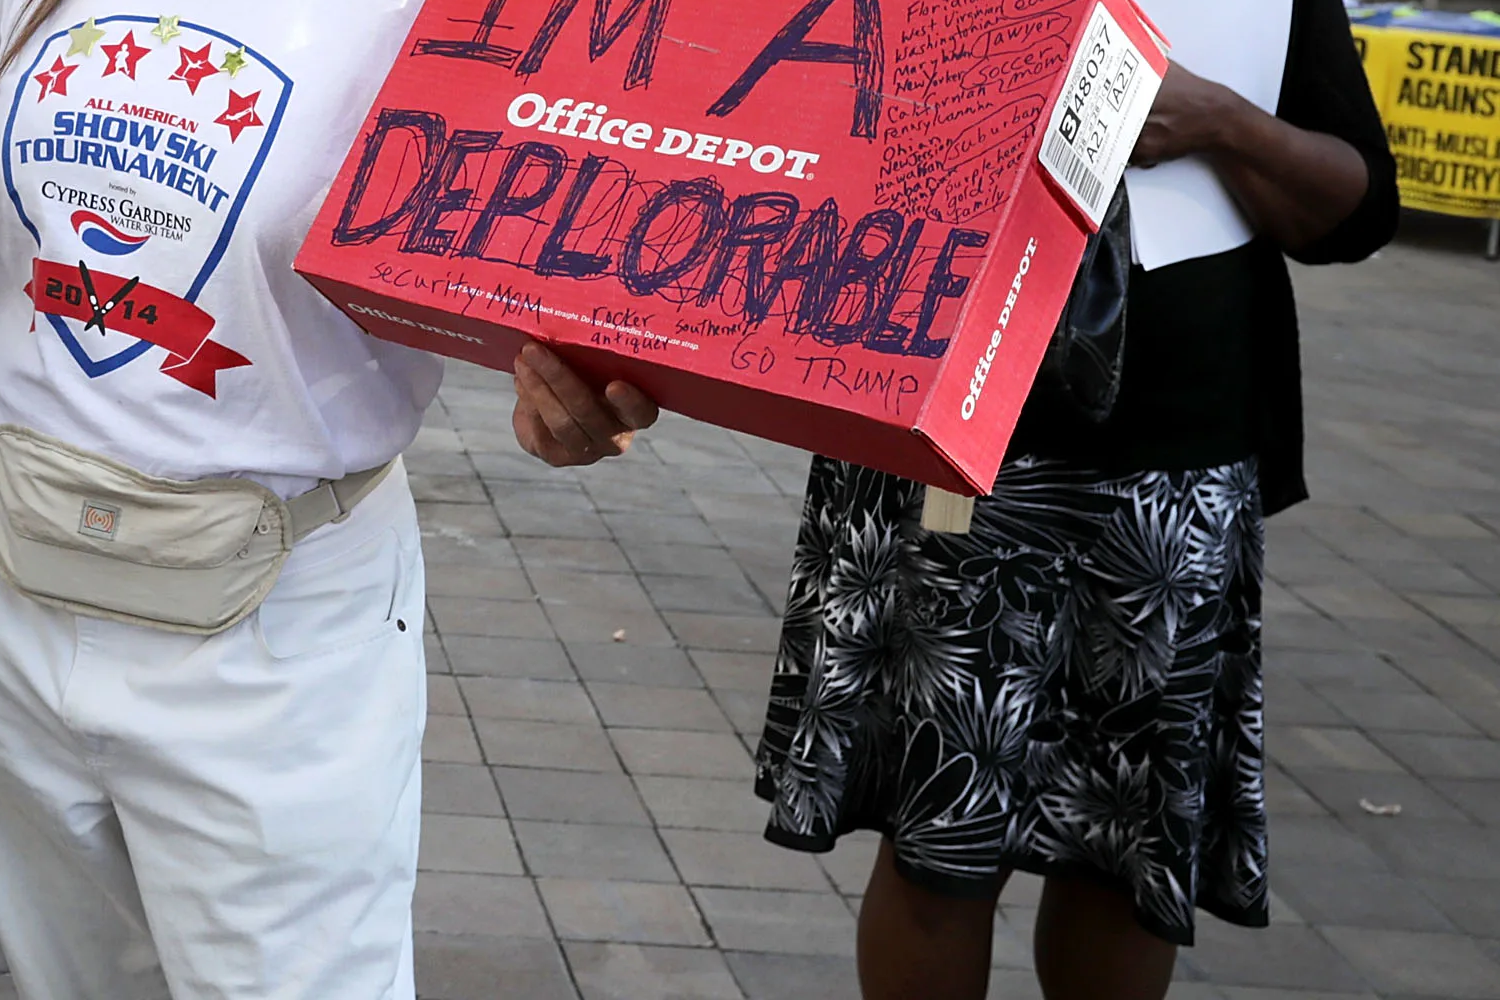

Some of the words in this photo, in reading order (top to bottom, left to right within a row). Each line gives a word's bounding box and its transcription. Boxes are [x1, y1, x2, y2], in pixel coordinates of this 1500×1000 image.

[979, 46, 1053, 84] soccer
[1008, 53, 1064, 88] mom
[1112, 60, 1134, 105] A21
[84, 97, 116, 114] ALL
[116, 104, 199, 134] AMERICAN
[1397, 77, 1500, 118] AGAINS
[53, 111, 164, 152] SHOW
[164, 135, 218, 174] SKI
[506, 92, 654, 148] Office
[659, 128, 820, 181] DEPOT
[948, 106, 1042, 161] suburban
[1086, 119, 1108, 164] A21
[15, 138, 229, 213] TOURNAMENT
[41, 180, 116, 215] CYPRESS
[118, 198, 192, 233] GARDENS
[110, 215, 144, 231] WATER
[145, 223, 160, 236] SKI
[160, 227, 184, 242] TEAM
[331, 107, 988, 359] DEPLORABLE
[368, 261, 481, 315] security
[961, 329, 1002, 421] Office
[998, 236, 1037, 329] DEPOT
[731, 333, 775, 375] GO
[795, 356, 919, 415] TRUMP
